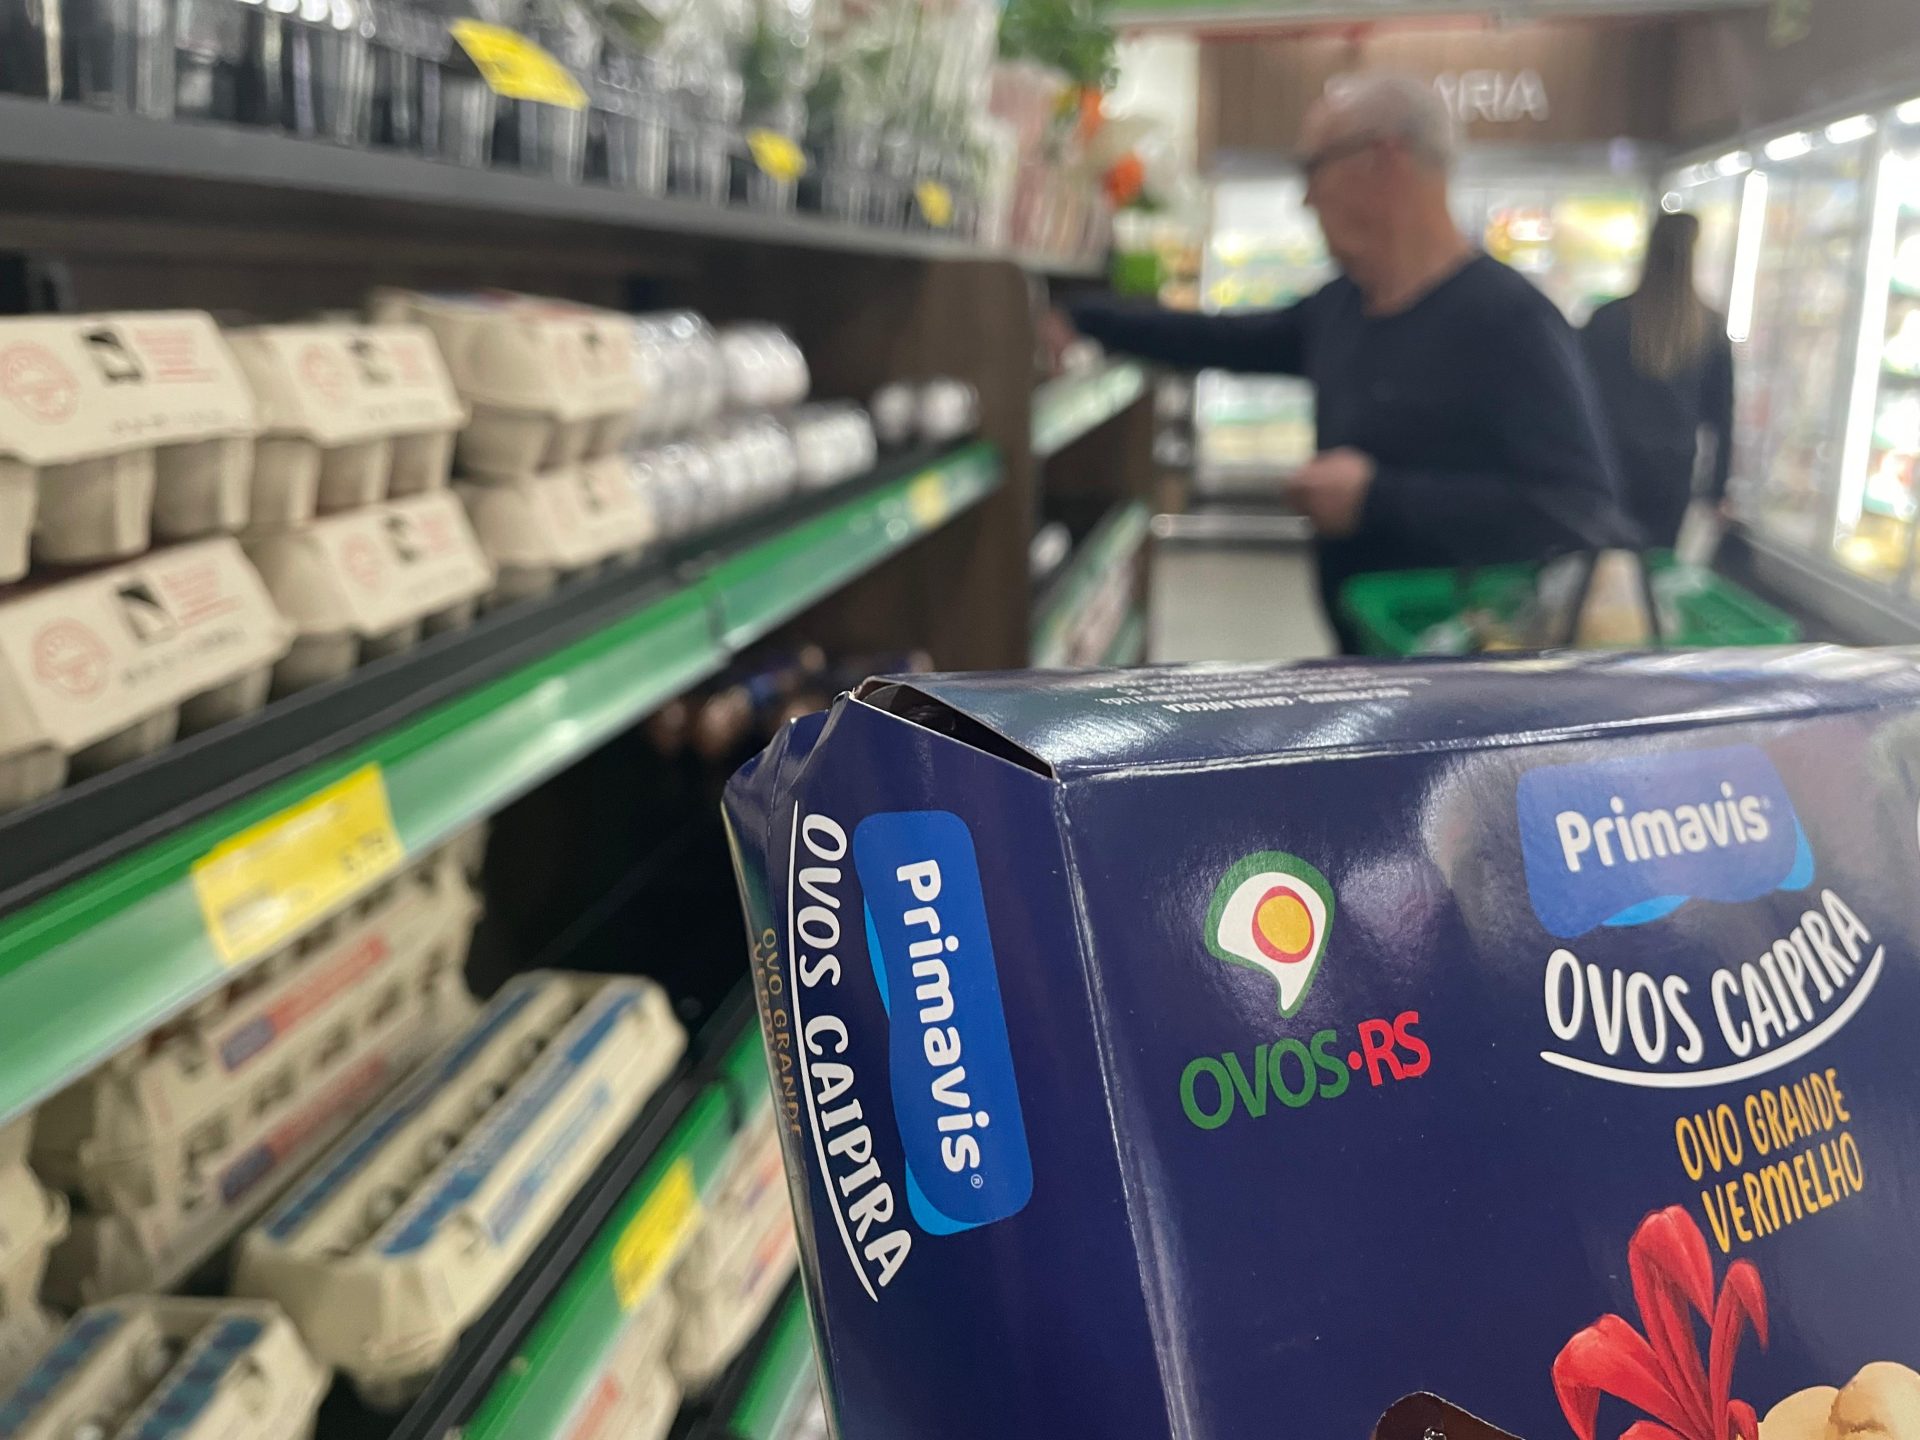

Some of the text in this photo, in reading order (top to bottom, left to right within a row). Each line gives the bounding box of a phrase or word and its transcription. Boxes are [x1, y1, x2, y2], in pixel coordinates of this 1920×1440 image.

[762, 927, 783, 996] OVO
[1544, 889, 1871, 1064] OVOS CAIPIRA
[797, 813, 912, 1287] OVOS CAIPIRA
[1675, 1068, 1851, 1181] OVO GRANDE
[1702, 1131, 1864, 1253] VERMELHO
